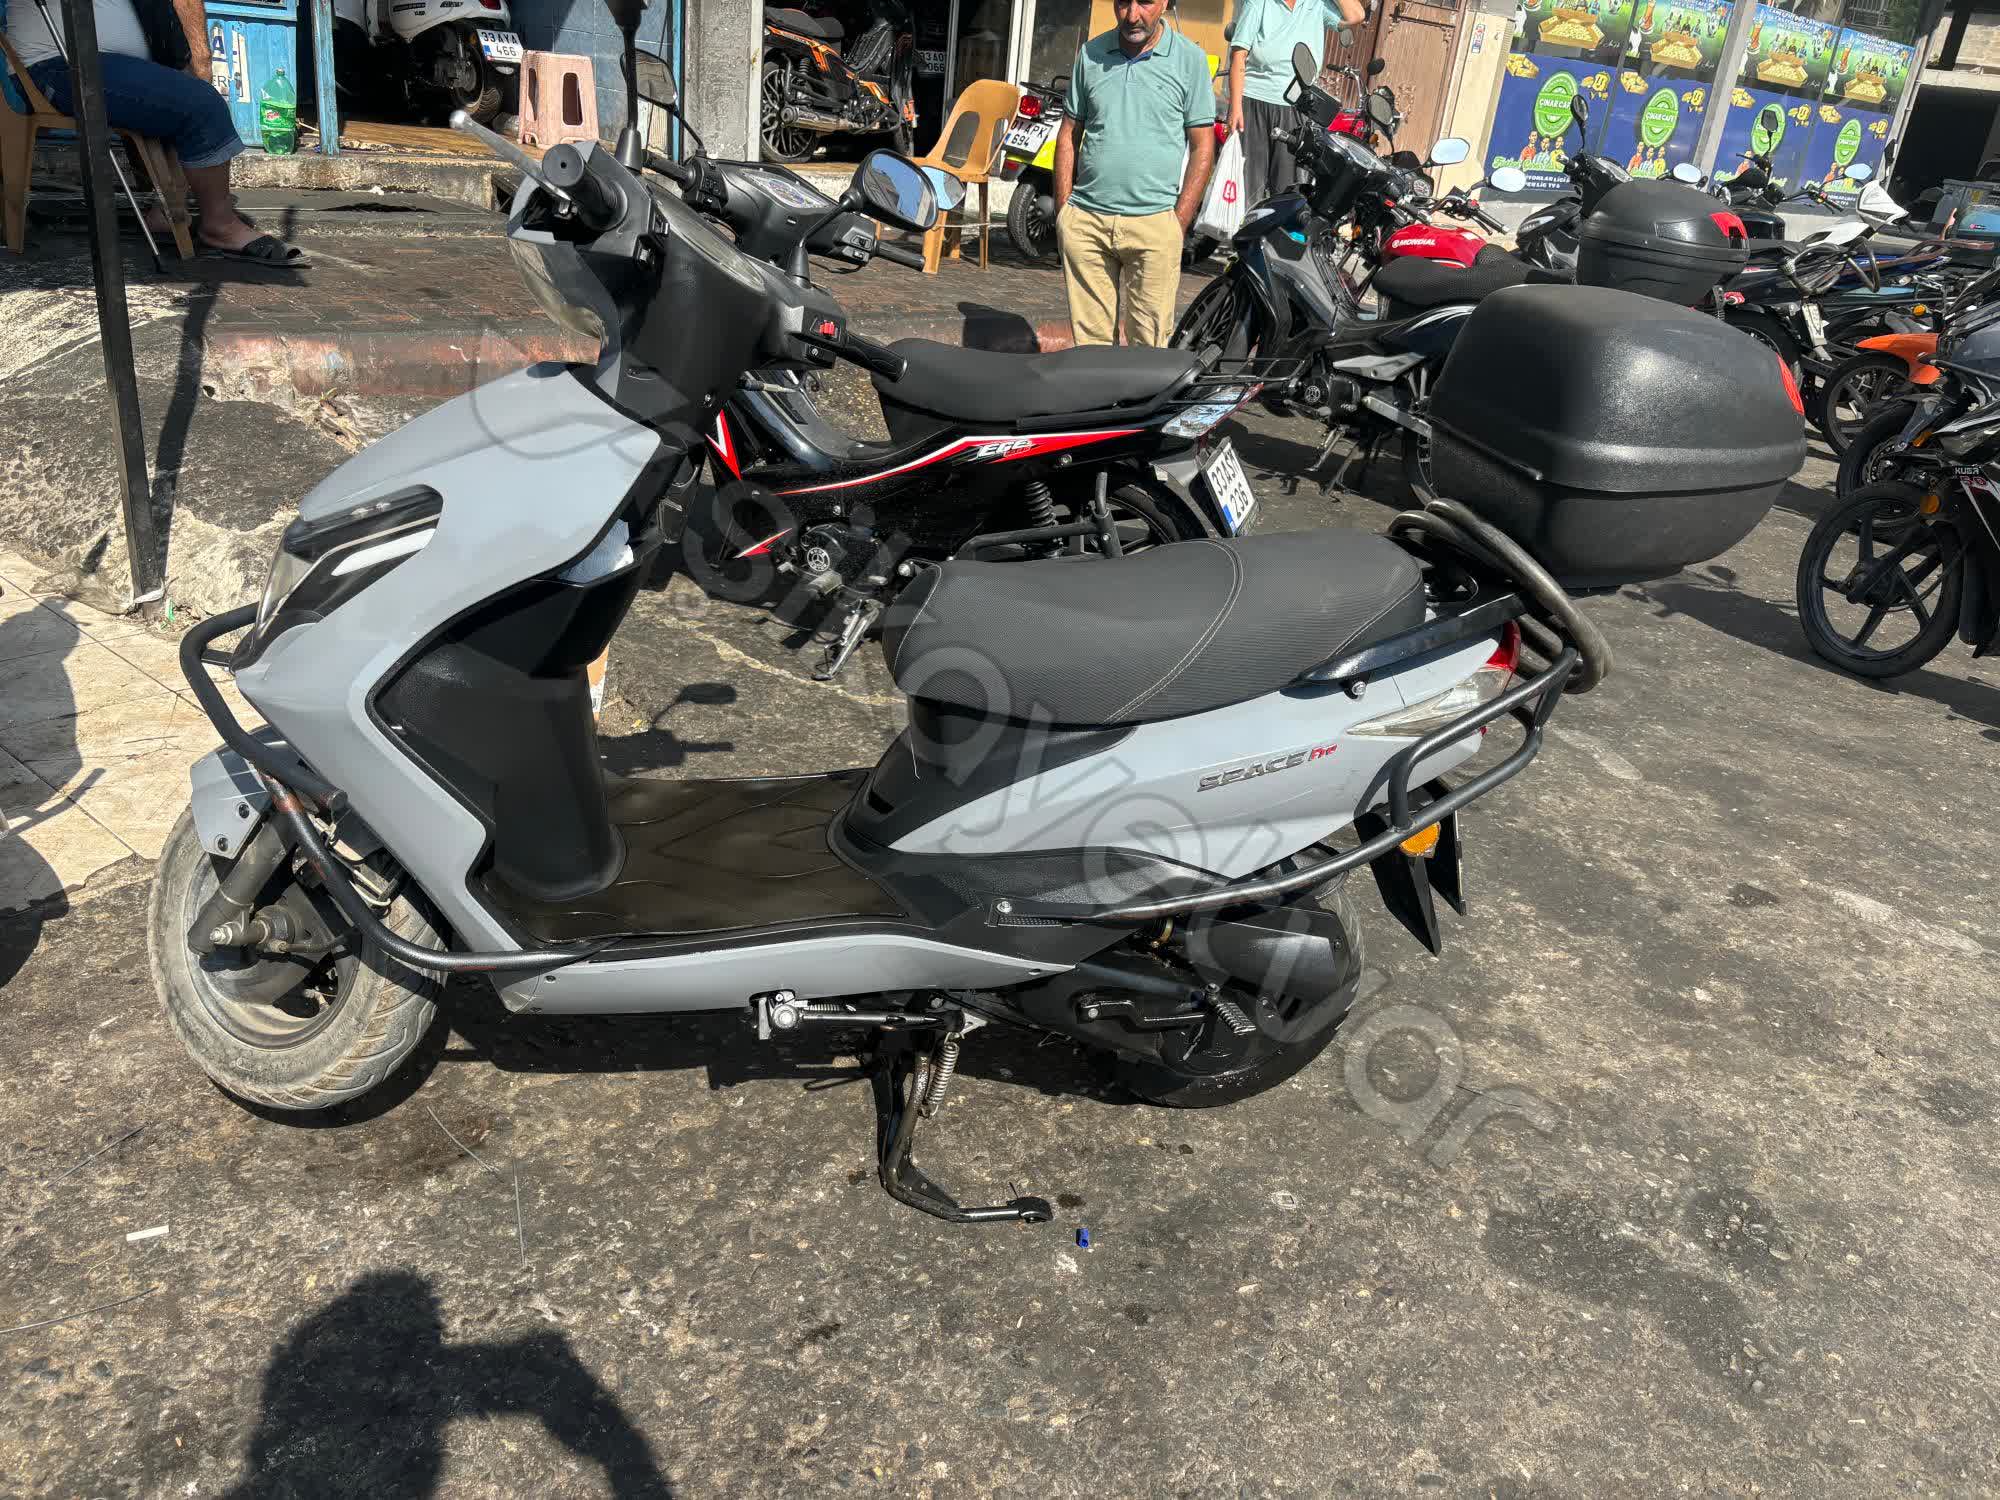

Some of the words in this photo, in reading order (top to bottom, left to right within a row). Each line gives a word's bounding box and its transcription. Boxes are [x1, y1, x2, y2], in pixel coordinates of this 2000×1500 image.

[481, 31, 496, 43] 33
[497, 33, 519, 45] AYA
[496, 45, 517, 57] 466
[1559, 100, 1571, 109] CAF
[1010, 119, 1024, 131] 01
[1024, 122, 1048, 139] APK
[1011, 133, 1030, 147] 694
[1400, 238, 1436, 247] MONDIAL
[1211, 467, 1228, 496] 33
[1230, 482, 1249, 519] 236
[1196, 749, 1310, 793] SPACE
